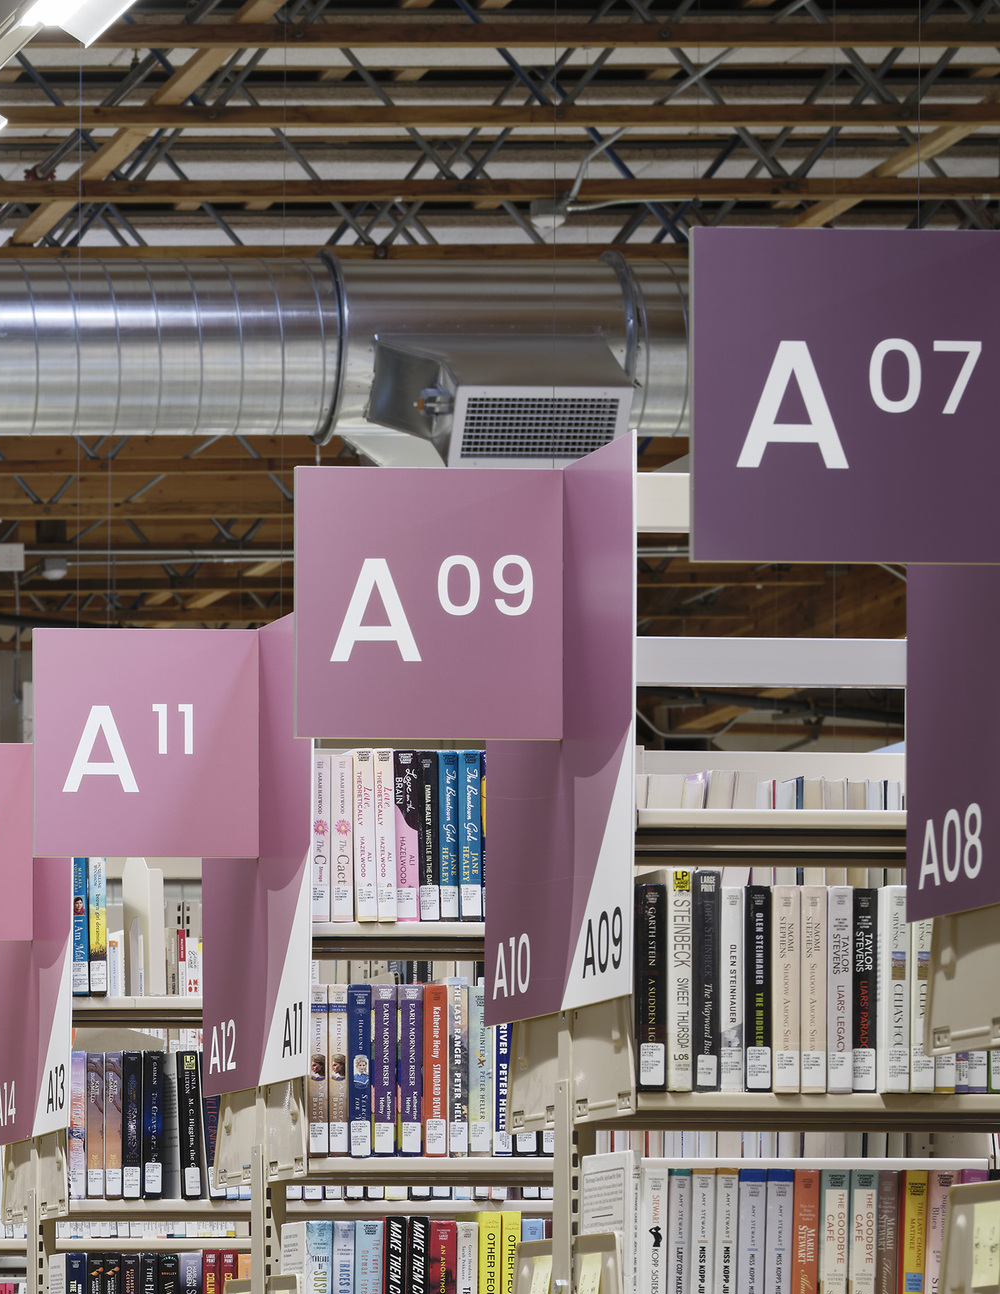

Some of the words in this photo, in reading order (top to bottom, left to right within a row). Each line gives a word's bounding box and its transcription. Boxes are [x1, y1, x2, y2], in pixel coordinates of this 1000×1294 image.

[356, 771, 364, 826] THEORETICALLY
[395, 777, 403, 805] BRAIN
[470, 851, 479, 875] JANE
[917, 802, 983, 891] A08
[675, 871, 688, 881] LP
[673, 899, 691, 968] STEINBECK
[755, 912, 764, 937] OLEN
[779, 916, 787, 959] STEPHENS
[582, 905, 624, 979] A09
[729, 944, 737, 967] OLEN
[833, 933, 841, 975] STEVENS
[841, 935, 849, 973] TAYLOR
[855, 931, 864, 973] STEVENS
[864, 933, 873, 971] TAYLOR
[492, 932, 531, 1001] A10
[755, 938, 764, 985] STEINHAUER
[676, 977, 689, 1006] SWEET
[704, 983, 713, 999] The
[729, 969, 737, 1024] STEINHAUER
[755, 992, 764, 1007] THE
[281, 1001, 303, 1059] A11
[382, 1003, 390, 1026] EARLY
[453, 1007, 461, 1025] LAST
[676, 1011, 689, 1049] THURSDA
[701, 1001, 713, 1038] Wayward
[755, 1009, 764, 1047] MIDDLEM
[208, 1018, 236, 1074] A12
[382, 1027, 390, 1060] MORNING
[453, 1026, 461, 1066] RANGER
[837, 1015, 846, 1053] LEGACY
[674, 1053, 689, 1061] LOS
[46, 1063, 65, 1114] A13
[382, 1062, 390, 1087] RISER
[453, 1070, 461, 1104] PETER
[652, 1194, 660, 1224] STEWART
[931, 1207, 939, 1230] Blues
[390, 1220, 402, 1251] MAKE
[827, 1214, 835, 1242] CAFÉ
[837, 1211, 845, 1264] GOODBYE
[487, 1233, 496, 1268] OTHER
[651, 1248, 659, 1267] KOPP
[698, 1246, 706, 1263] MISS
[390, 1252, 402, 1285] THEM
[651, 1269, 659, 1294] SISTERS
[698, 1265, 706, 1284] KOPP
